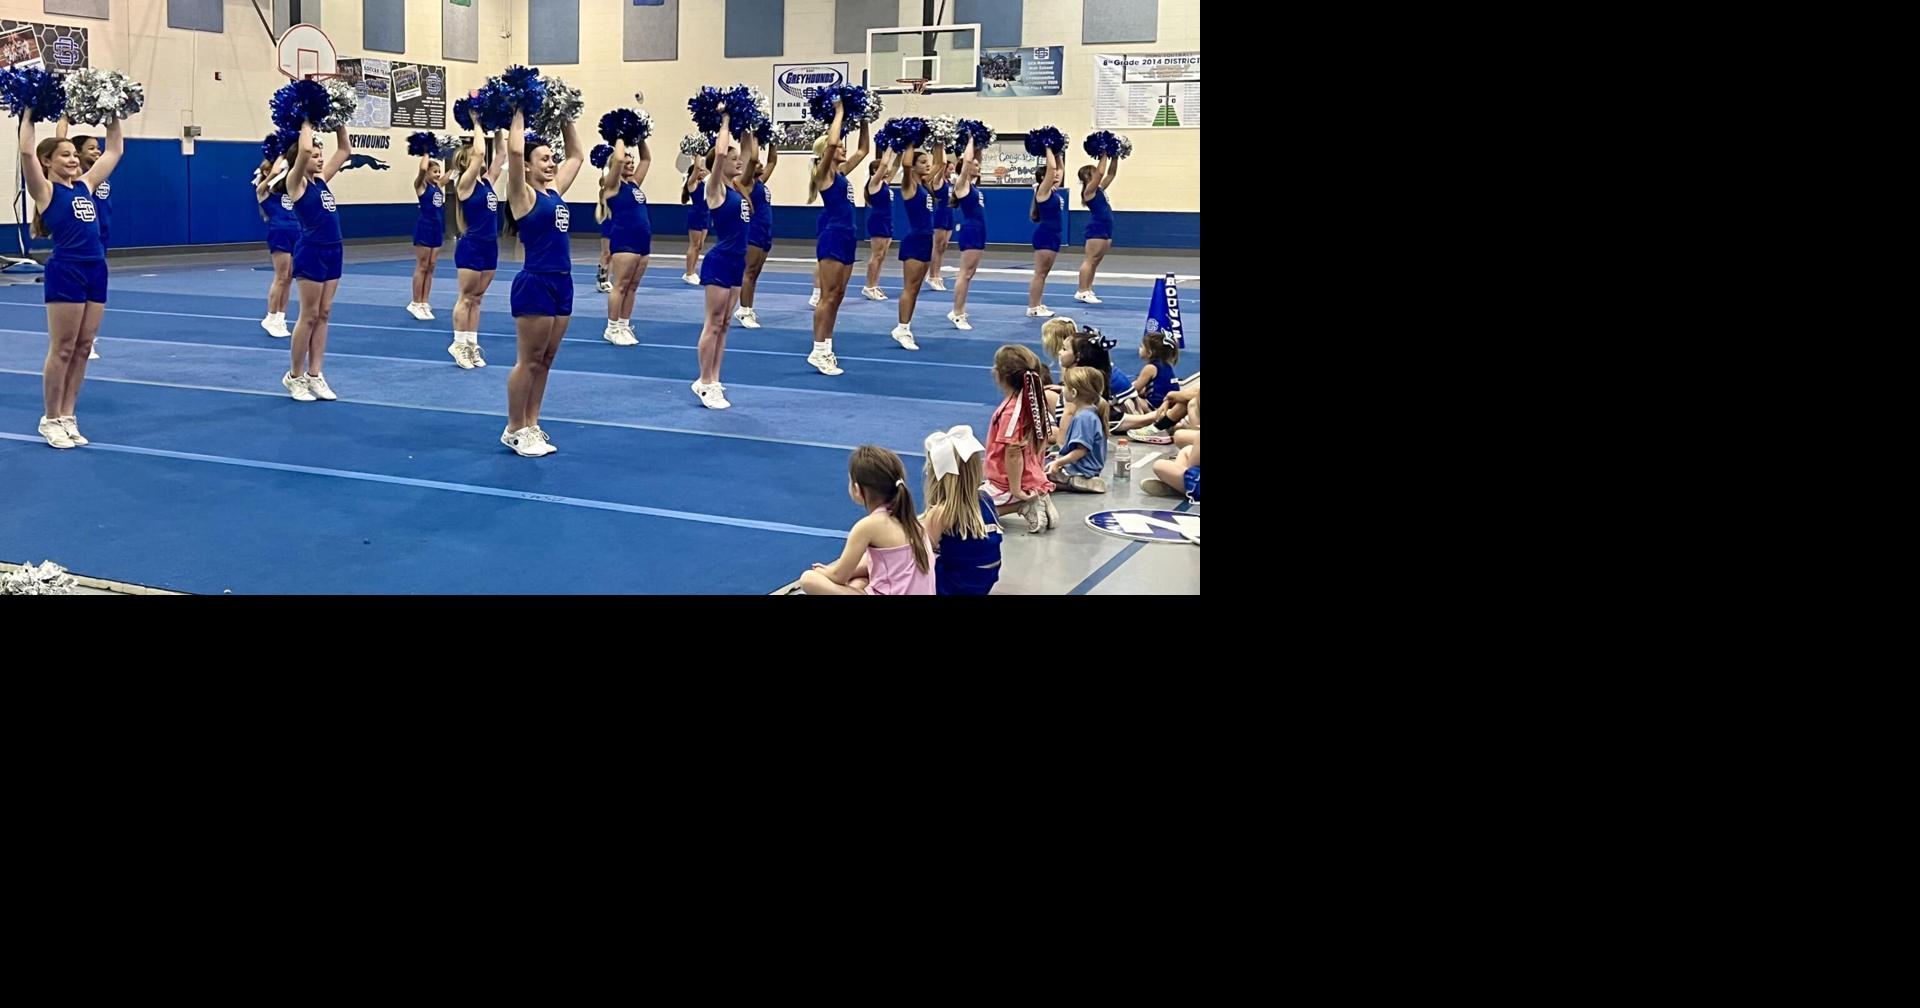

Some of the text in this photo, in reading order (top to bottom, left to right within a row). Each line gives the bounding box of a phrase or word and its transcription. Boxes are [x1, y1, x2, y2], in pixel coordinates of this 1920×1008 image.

[1164, 57, 1200, 65] DISTRICT
[786, 72, 835, 84] GREYHOUNDS
[349, 134, 390, 149] REYHOUNDS
